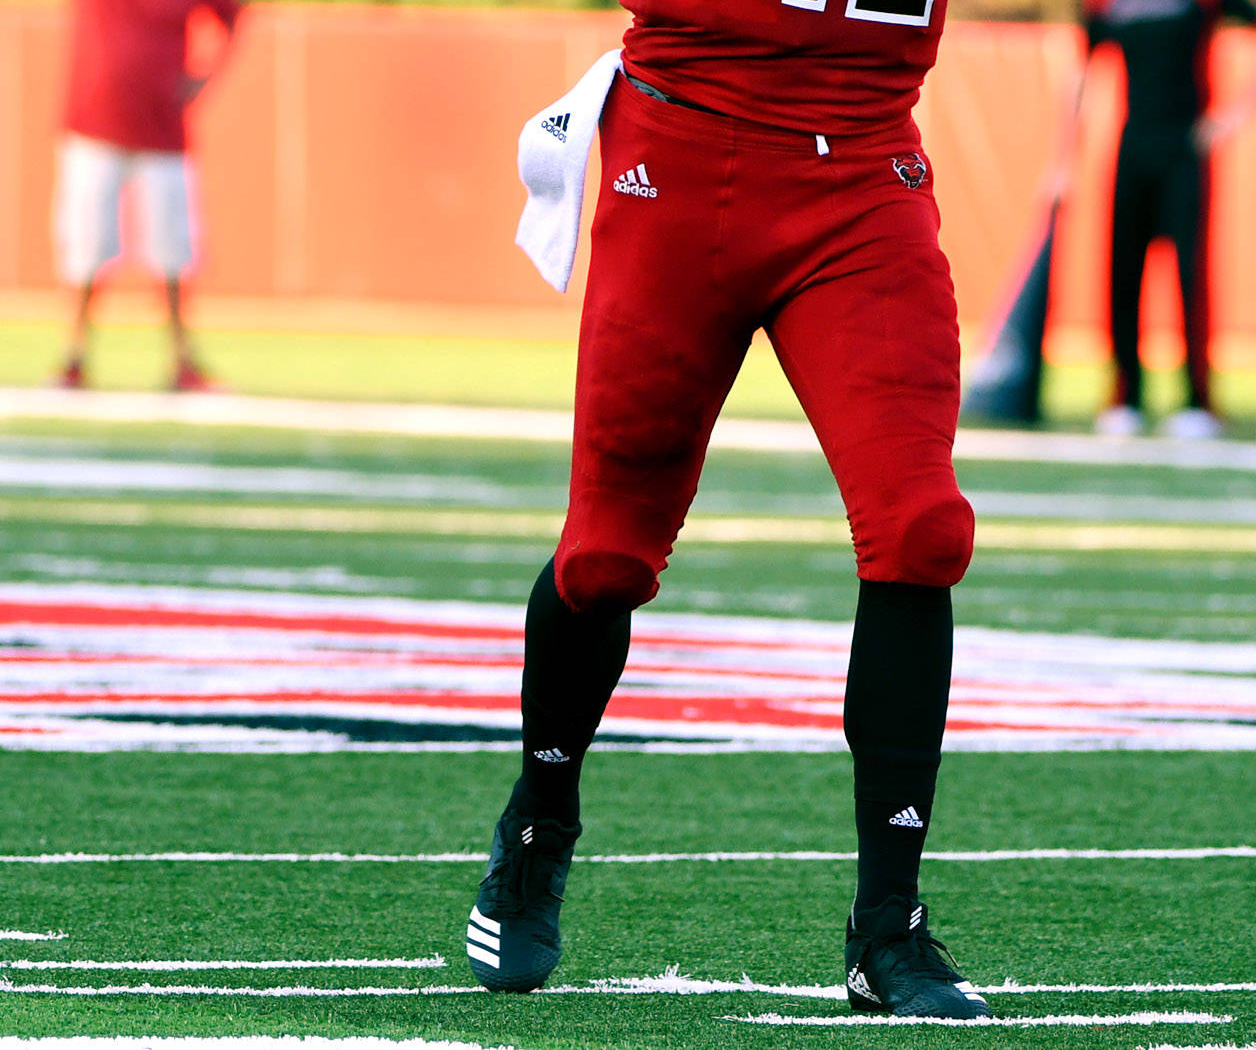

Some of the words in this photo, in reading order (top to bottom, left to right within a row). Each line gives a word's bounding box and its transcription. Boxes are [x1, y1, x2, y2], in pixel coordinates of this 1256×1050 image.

[541, 120, 568, 144] adidas
[613, 180, 658, 199] adidas
[889, 817, 924, 828] adidas
